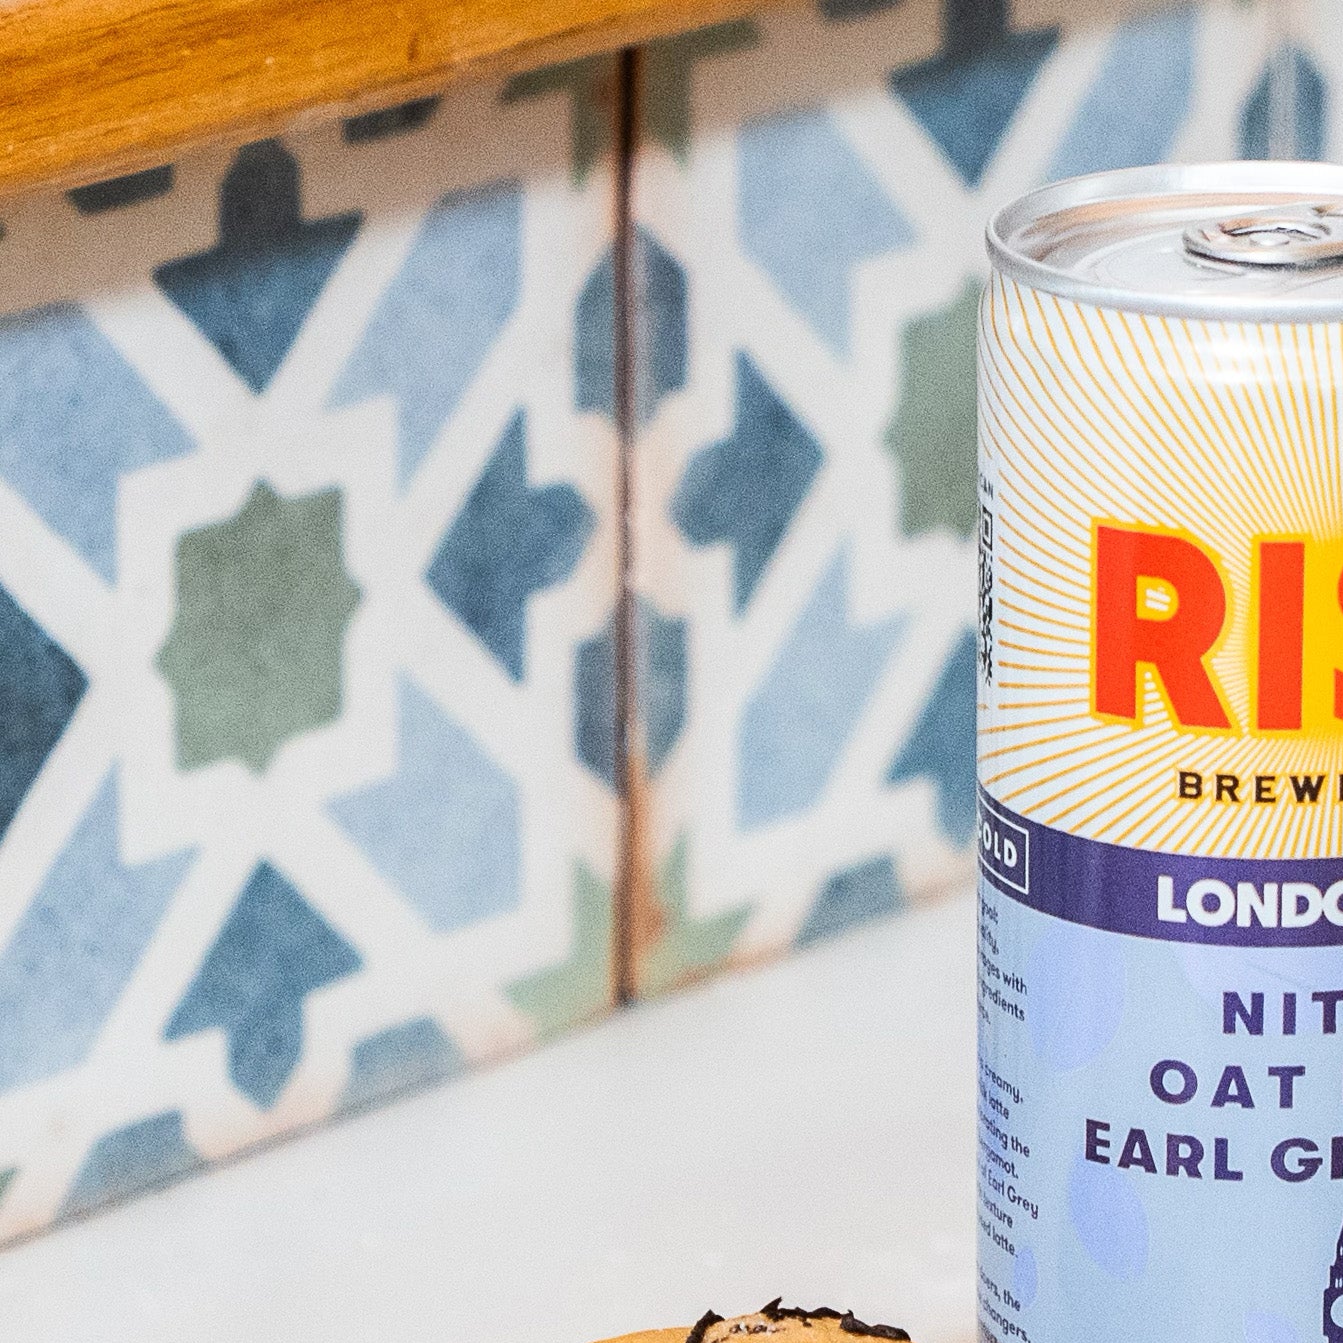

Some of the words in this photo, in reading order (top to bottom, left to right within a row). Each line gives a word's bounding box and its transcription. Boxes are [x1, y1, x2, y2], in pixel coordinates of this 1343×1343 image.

[980, 820, 1018, 868] OLD
[1002, 972, 1028, 995] with
[1150, 1059, 1306, 1109] OAT
[1011, 1135, 1030, 1158] the
[1085, 1118, 1243, 1181] EARL
[1007, 1185, 1039, 1220] Grey
